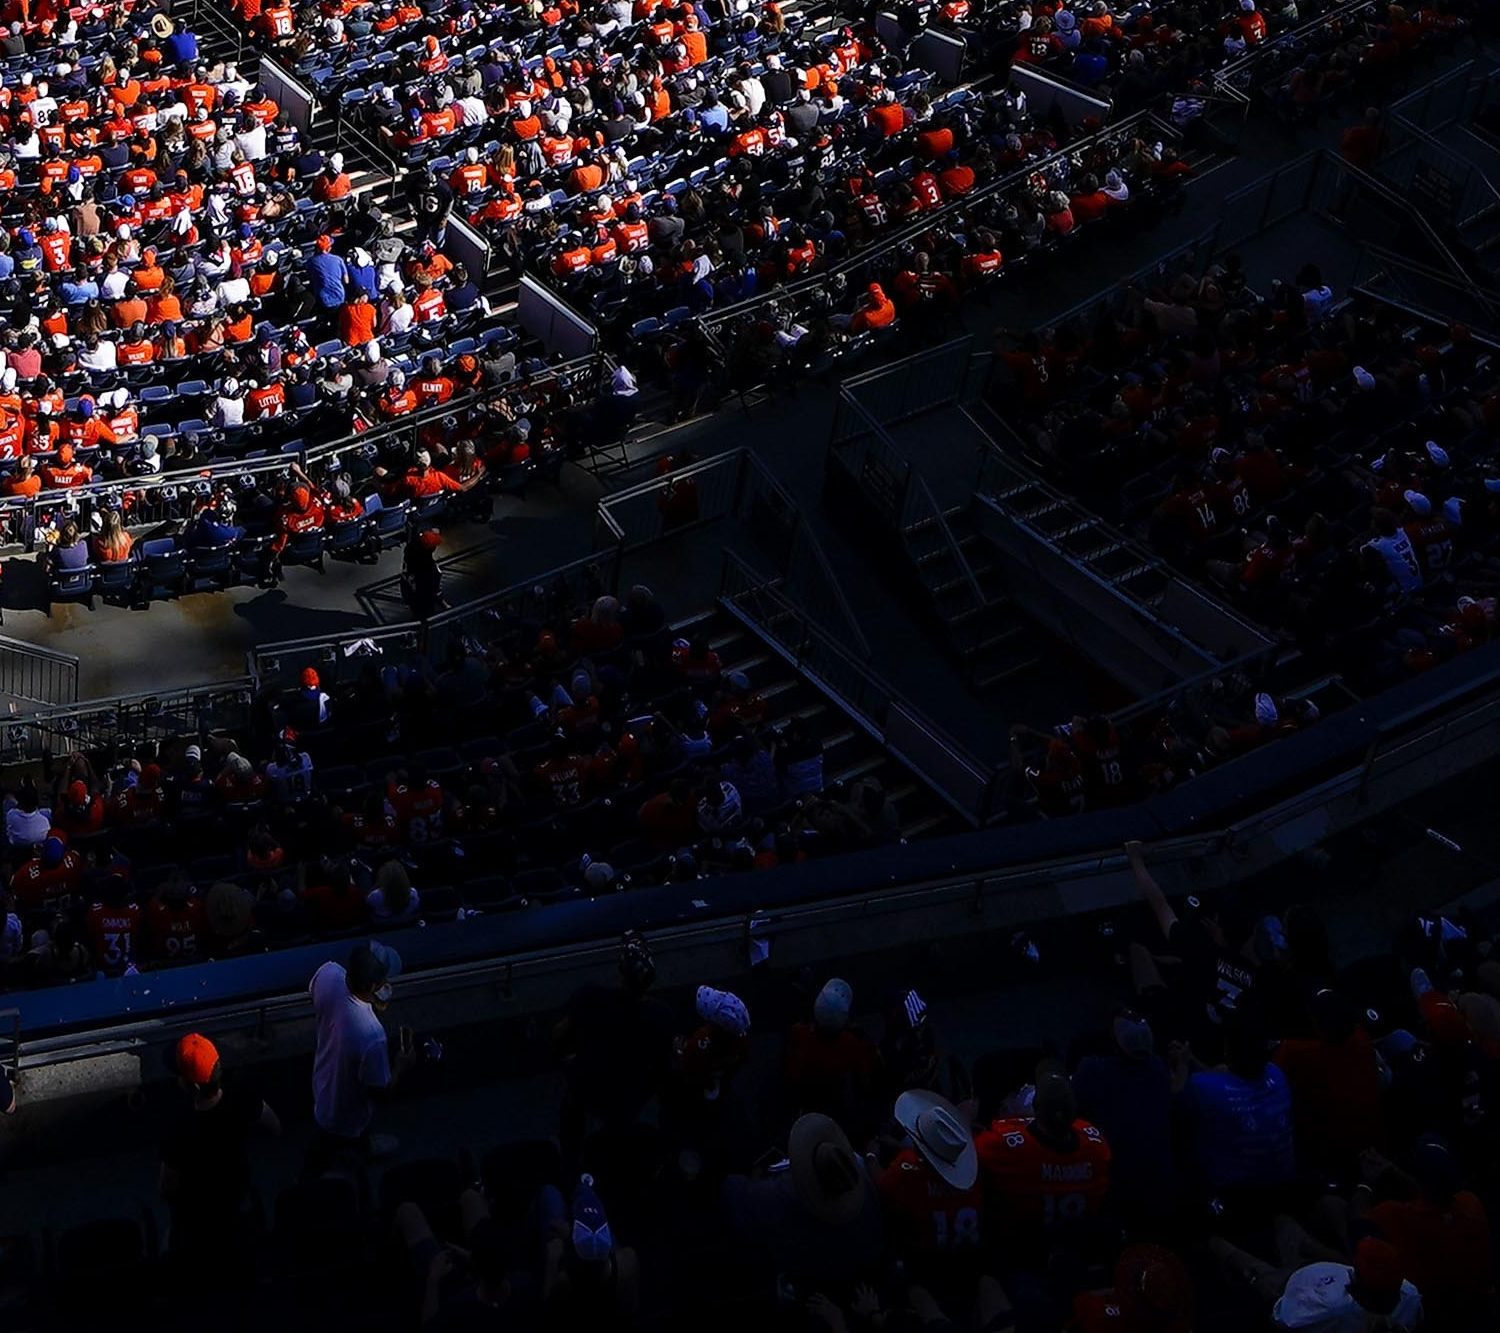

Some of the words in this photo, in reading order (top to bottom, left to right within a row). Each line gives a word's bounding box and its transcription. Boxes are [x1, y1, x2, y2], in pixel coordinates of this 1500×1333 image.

[105, 933, 132, 961] 31
[163, 935, 197, 957] 95
[1040, 1161, 1095, 1183] MANNING
